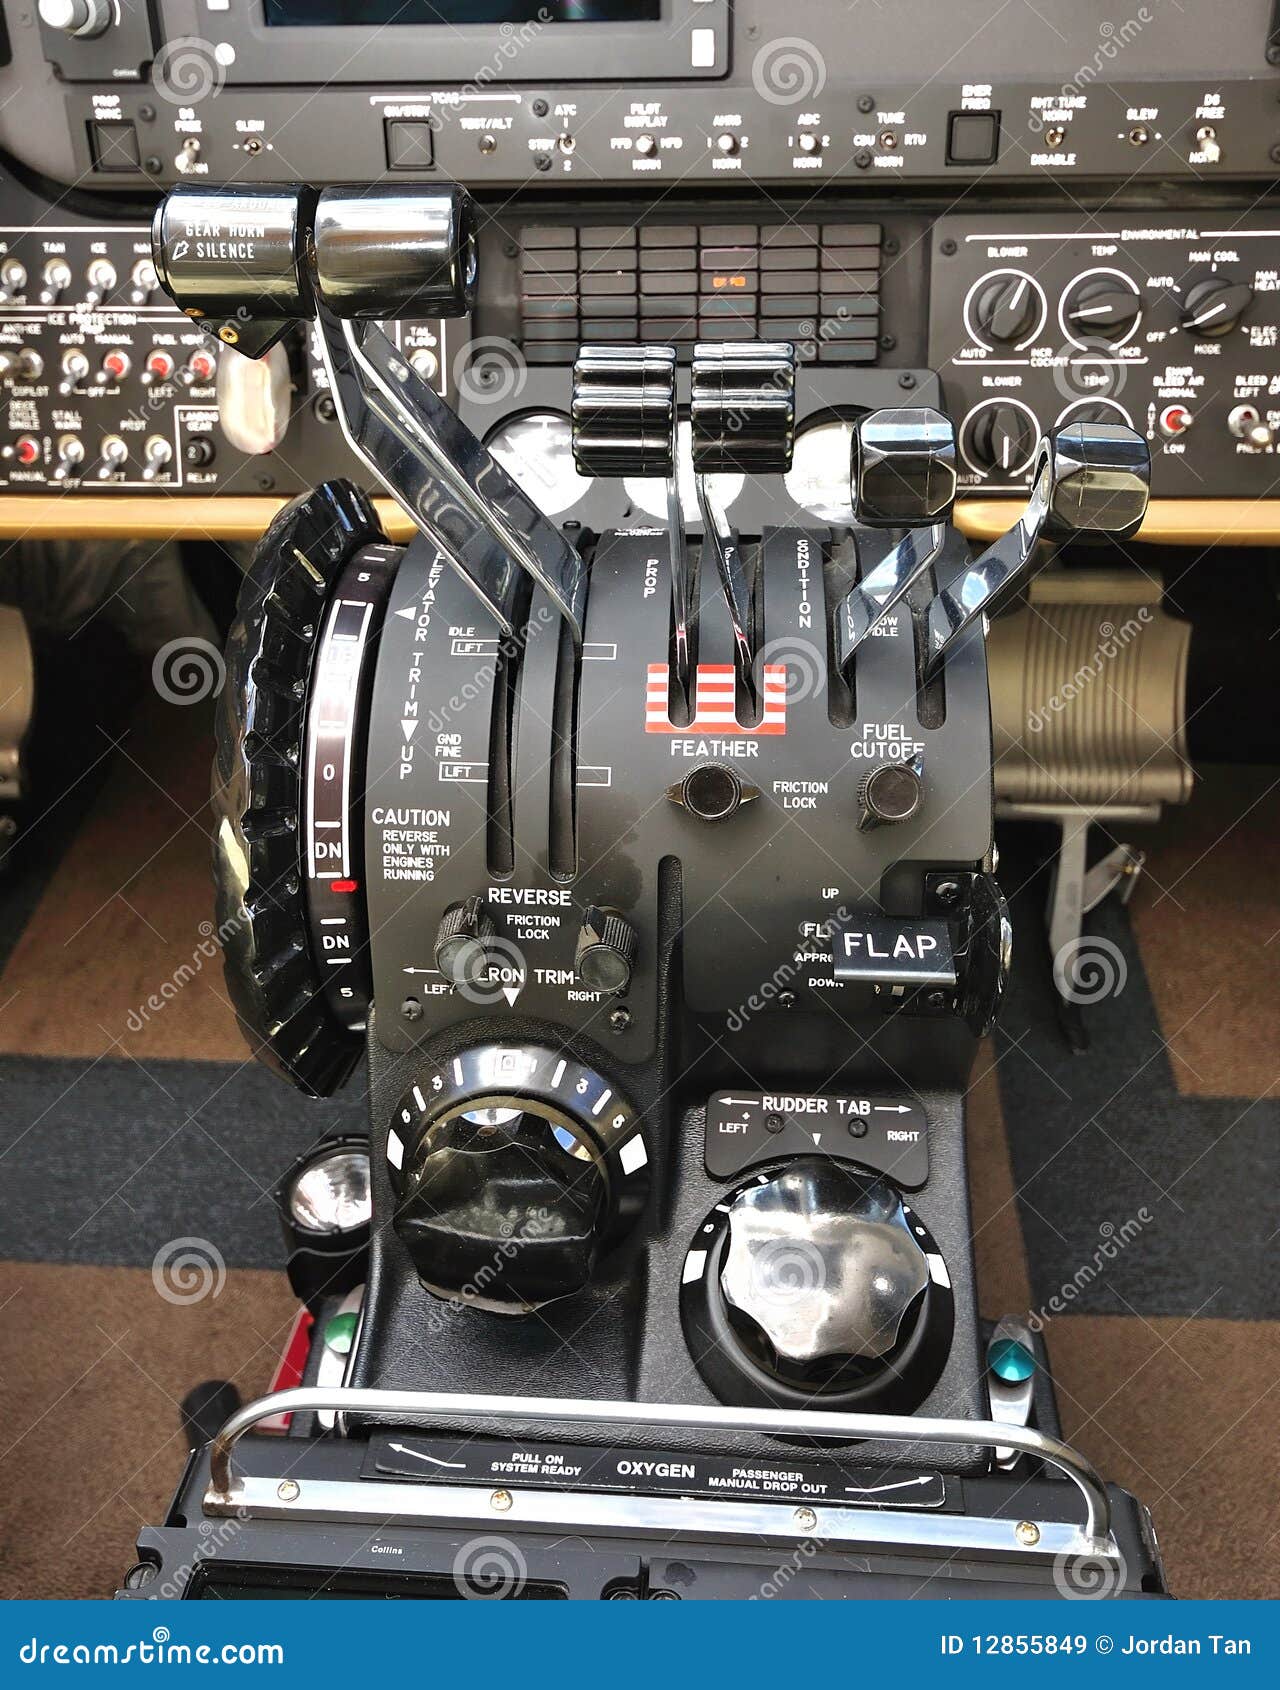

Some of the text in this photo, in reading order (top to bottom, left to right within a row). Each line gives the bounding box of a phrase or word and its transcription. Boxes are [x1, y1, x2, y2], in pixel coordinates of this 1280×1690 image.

[554, 104, 578, 116] ATC
[630, 103, 662, 116] PILOT
[185, 223, 265, 238] GEAR HORN
[1121, 229, 1200, 241] ENVIRONMENTAL
[196, 242, 256, 260] SILENCE
[987, 246, 1028, 258] BLOWER
[1091, 245, 1118, 256] TEMP
[1146, 277, 1174, 288] AUTO
[68, 313, 138, 326] PROTECTION
[959, 348, 987, 359] AUTO
[982, 375, 1023, 387] BLOWER
[1083, 375, 1110, 387] TEMP
[1233, 387, 1260, 398] LEFT
[188, 446, 197, 459] 2
[1163, 443, 1186, 454] LOW
[643, 558, 660, 599] PROP
[796, 539, 812, 629] CONDITION
[877, 616, 899, 627] OW
[448, 627, 476, 637] IDLE
[456, 643, 483, 653] LIFT
[403, 652, 424, 717] TRIM
[862, 724, 913, 741] FUEL
[436, 734, 462, 745] GND
[435, 746, 462, 758] FINE
[670, 740, 759, 758] FEATHER
[850, 742, 925, 759] CUTOFF
[399, 745, 414, 781] UP
[322, 764, 336, 781] 0
[445, 767, 473, 778] LIFT
[773, 781, 829, 794] FRICTION
[783, 796, 817, 809] LOCK
[371, 807, 451, 827] CAUTION
[382, 829, 439, 843] REVERSE
[314, 842, 343, 859] DN
[382, 843, 450, 857] ONLY WITH
[382, 856, 434, 869] ENGINES
[383, 868, 435, 882] RUNNING
[487, 887, 573, 906] REVERSE
[822, 888, 840, 899] UP
[506, 914, 561, 927] FRICTION
[517, 928, 551, 940] LOCK
[322, 936, 350, 950] DN
[843, 932, 938, 958] FLAP
[533, 968, 574, 984] TRIM
[340, 987, 354, 998] 5
[424, 983, 455, 995] LEFT
[567, 991, 602, 1002] RIGHT
[762, 1096, 872, 1116] RUDDER TAB
[719, 1122, 748, 1134] LEFT
[887, 1131, 919, 1142] RIGHT
[511, 1452, 564, 1467] PULL ON
[490, 1461, 582, 1477] SYSTEM READY
[616, 1460, 696, 1480] OXYGEN
[731, 1467, 805, 1484] PASSENGER
[708, 1475, 828, 1495] MANUAL DROP OUT
[371, 1545, 403, 1555] Collins
